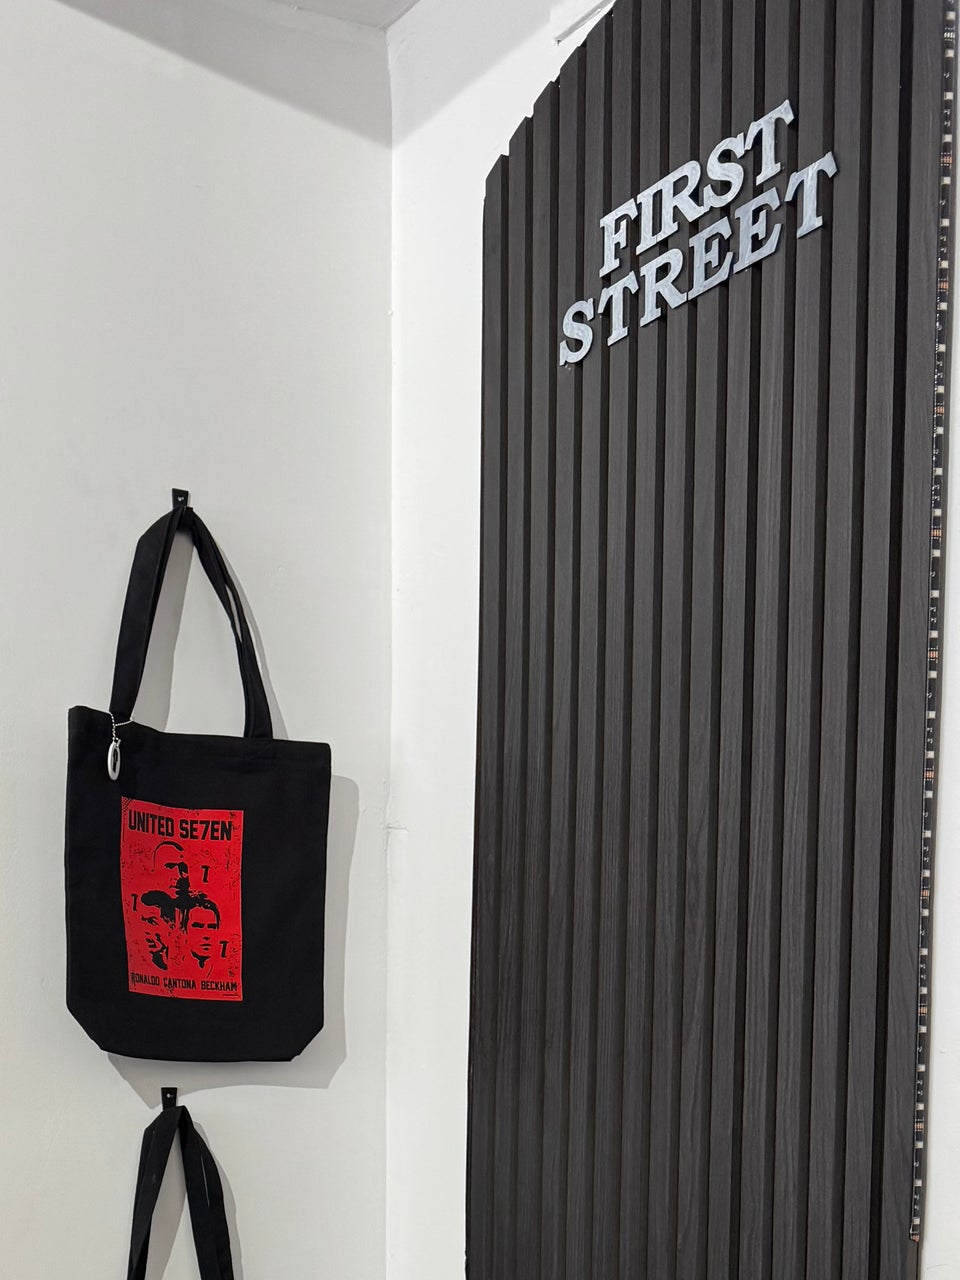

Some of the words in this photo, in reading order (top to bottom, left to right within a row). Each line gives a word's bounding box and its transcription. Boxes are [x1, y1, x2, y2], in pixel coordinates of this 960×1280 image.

[599, 99, 795, 278] FIRST
[559, 151, 838, 366] STREET
[128, 809, 174, 838] UNITED
[179, 820, 234, 841] SE7EN
[130, 972, 160, 987] RONALDO
[163, 977, 197, 990] CANTONA
[200, 979, 238, 992] BECKHAM
